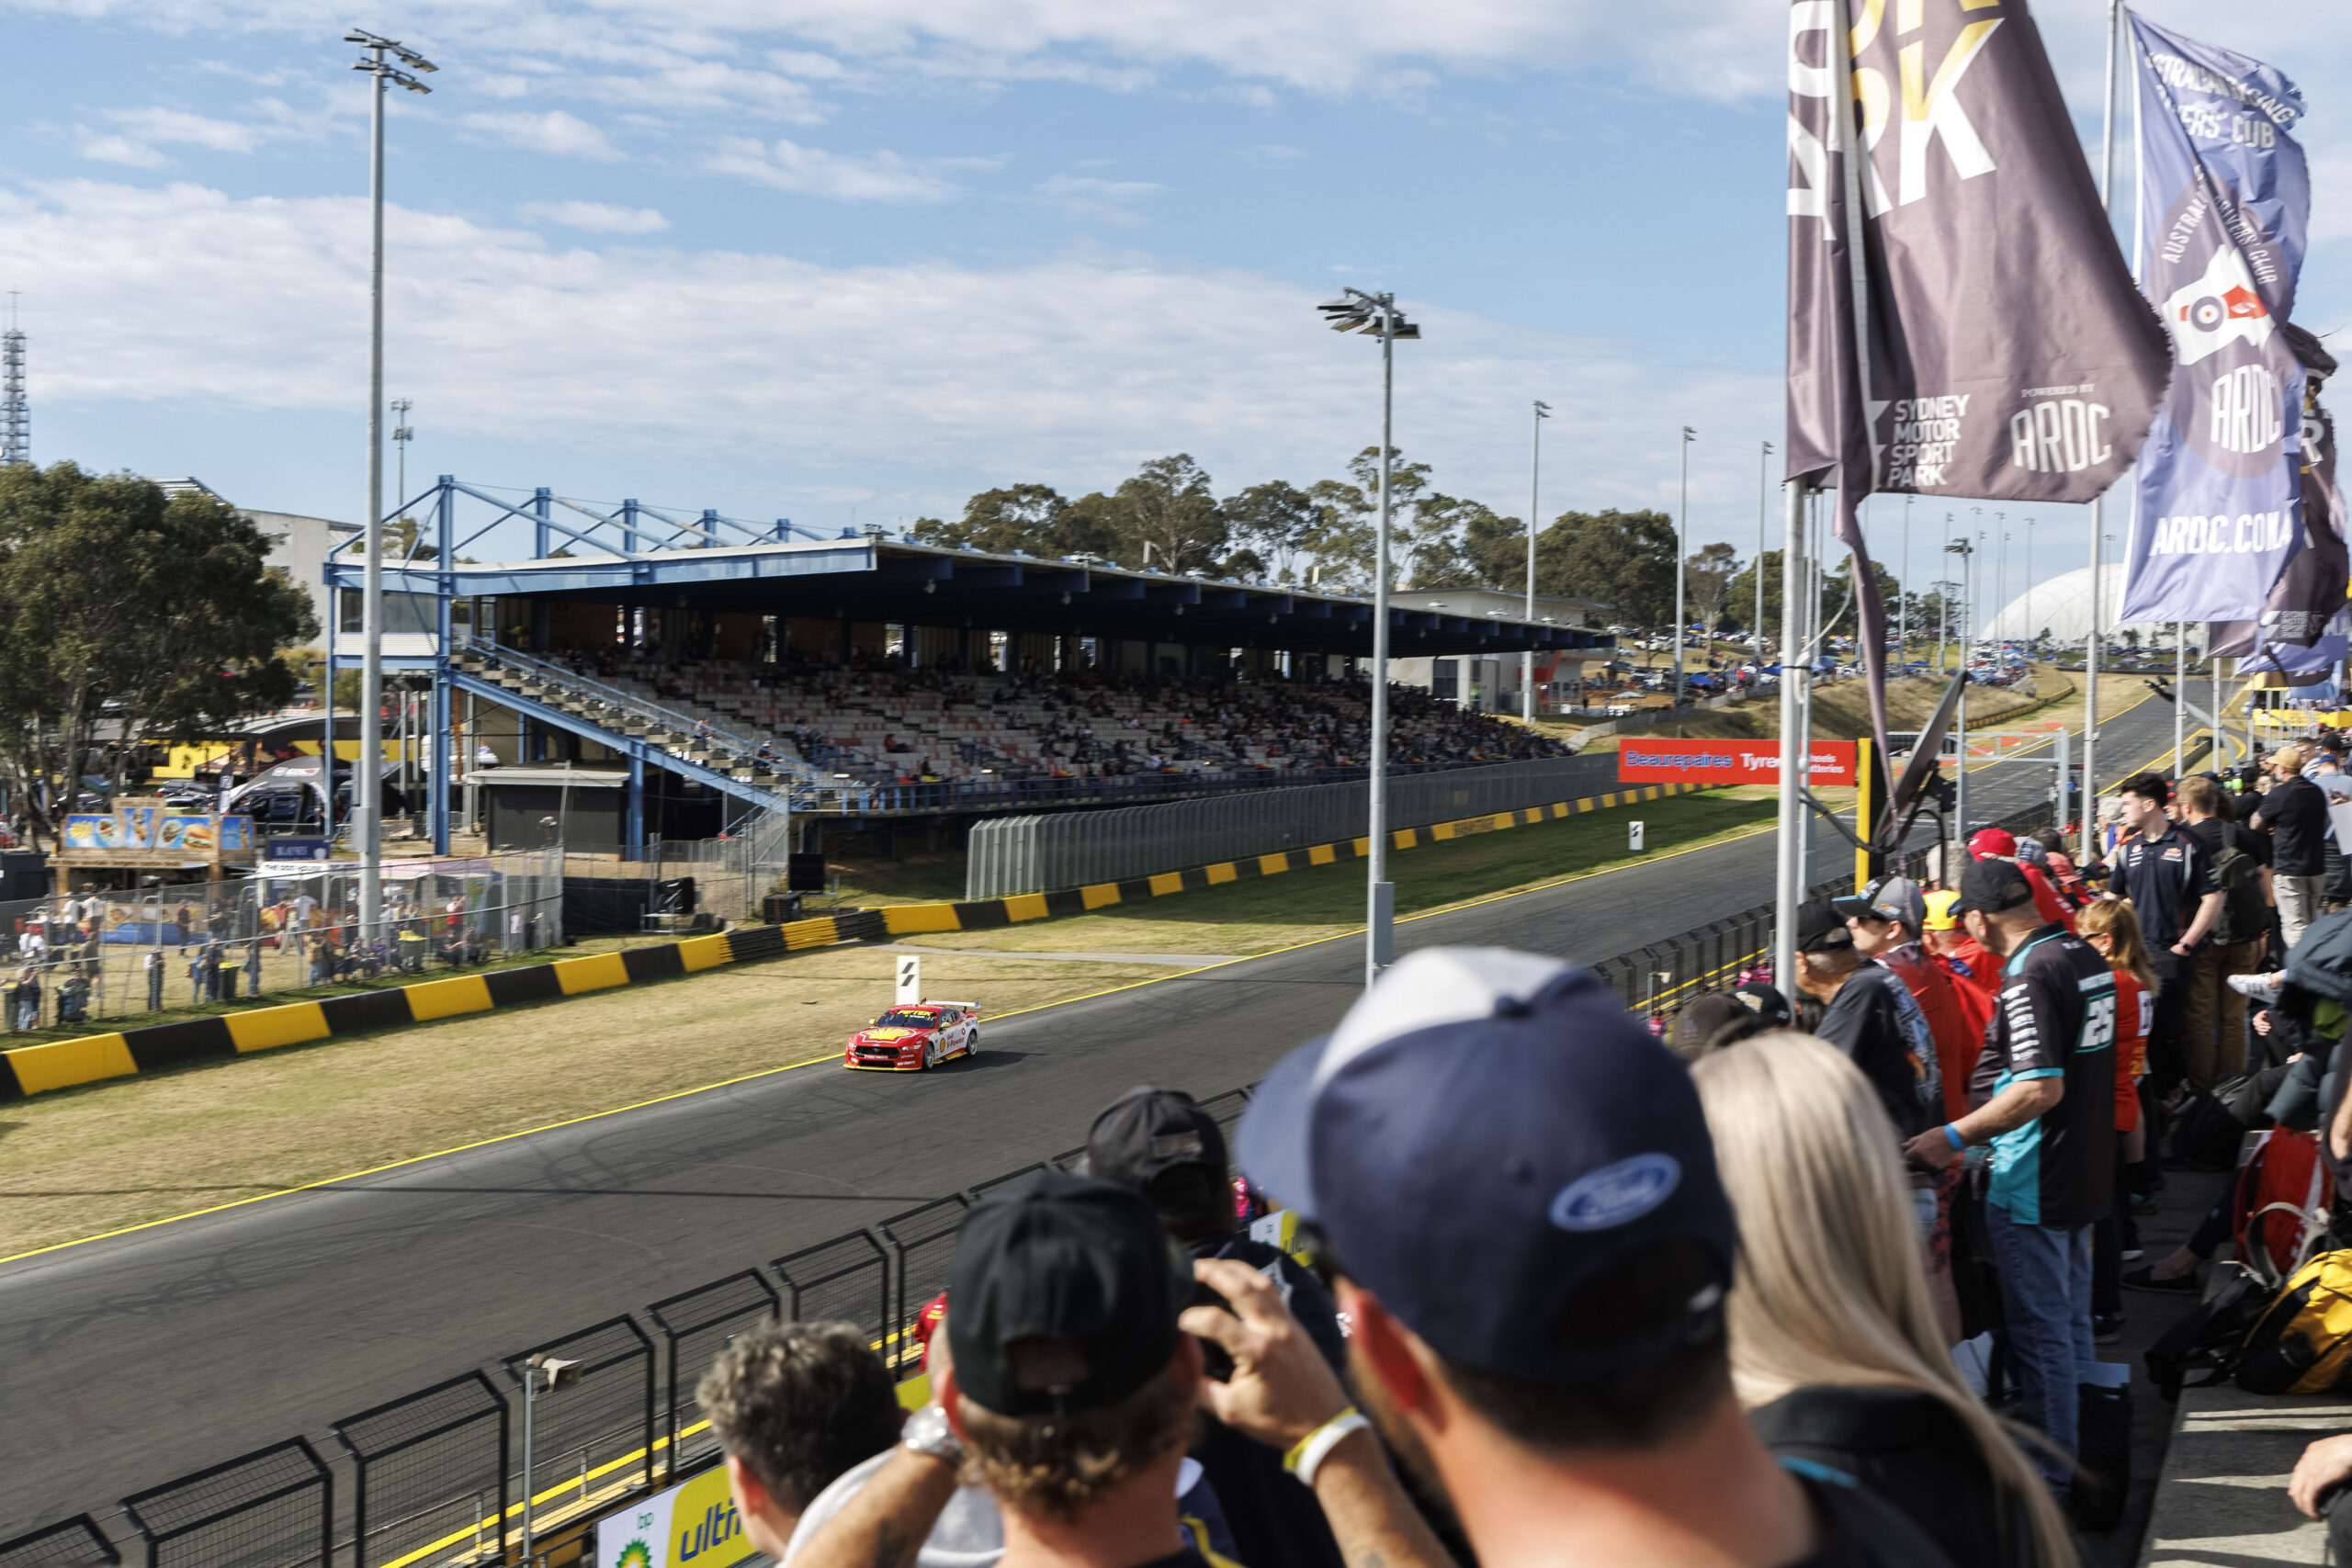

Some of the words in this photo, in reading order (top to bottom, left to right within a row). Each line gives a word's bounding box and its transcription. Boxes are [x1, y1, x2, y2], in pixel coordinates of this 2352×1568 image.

[1894, 394, 1971, 422] SYDNEY
[2211, 364, 2281, 453] ARDC
[1893, 419, 1962, 444] MOTOR
[2010, 400, 2112, 473] ARDC
[1890, 441, 1956, 466] SPORT
[1887, 464, 1948, 488] PARK
[1625, 750, 1733, 771] Beaurepaires
[1739, 753, 1781, 771] Tyre
[2080, 996, 2116, 1047] 25
[636, 1512, 655, 1530] bp
